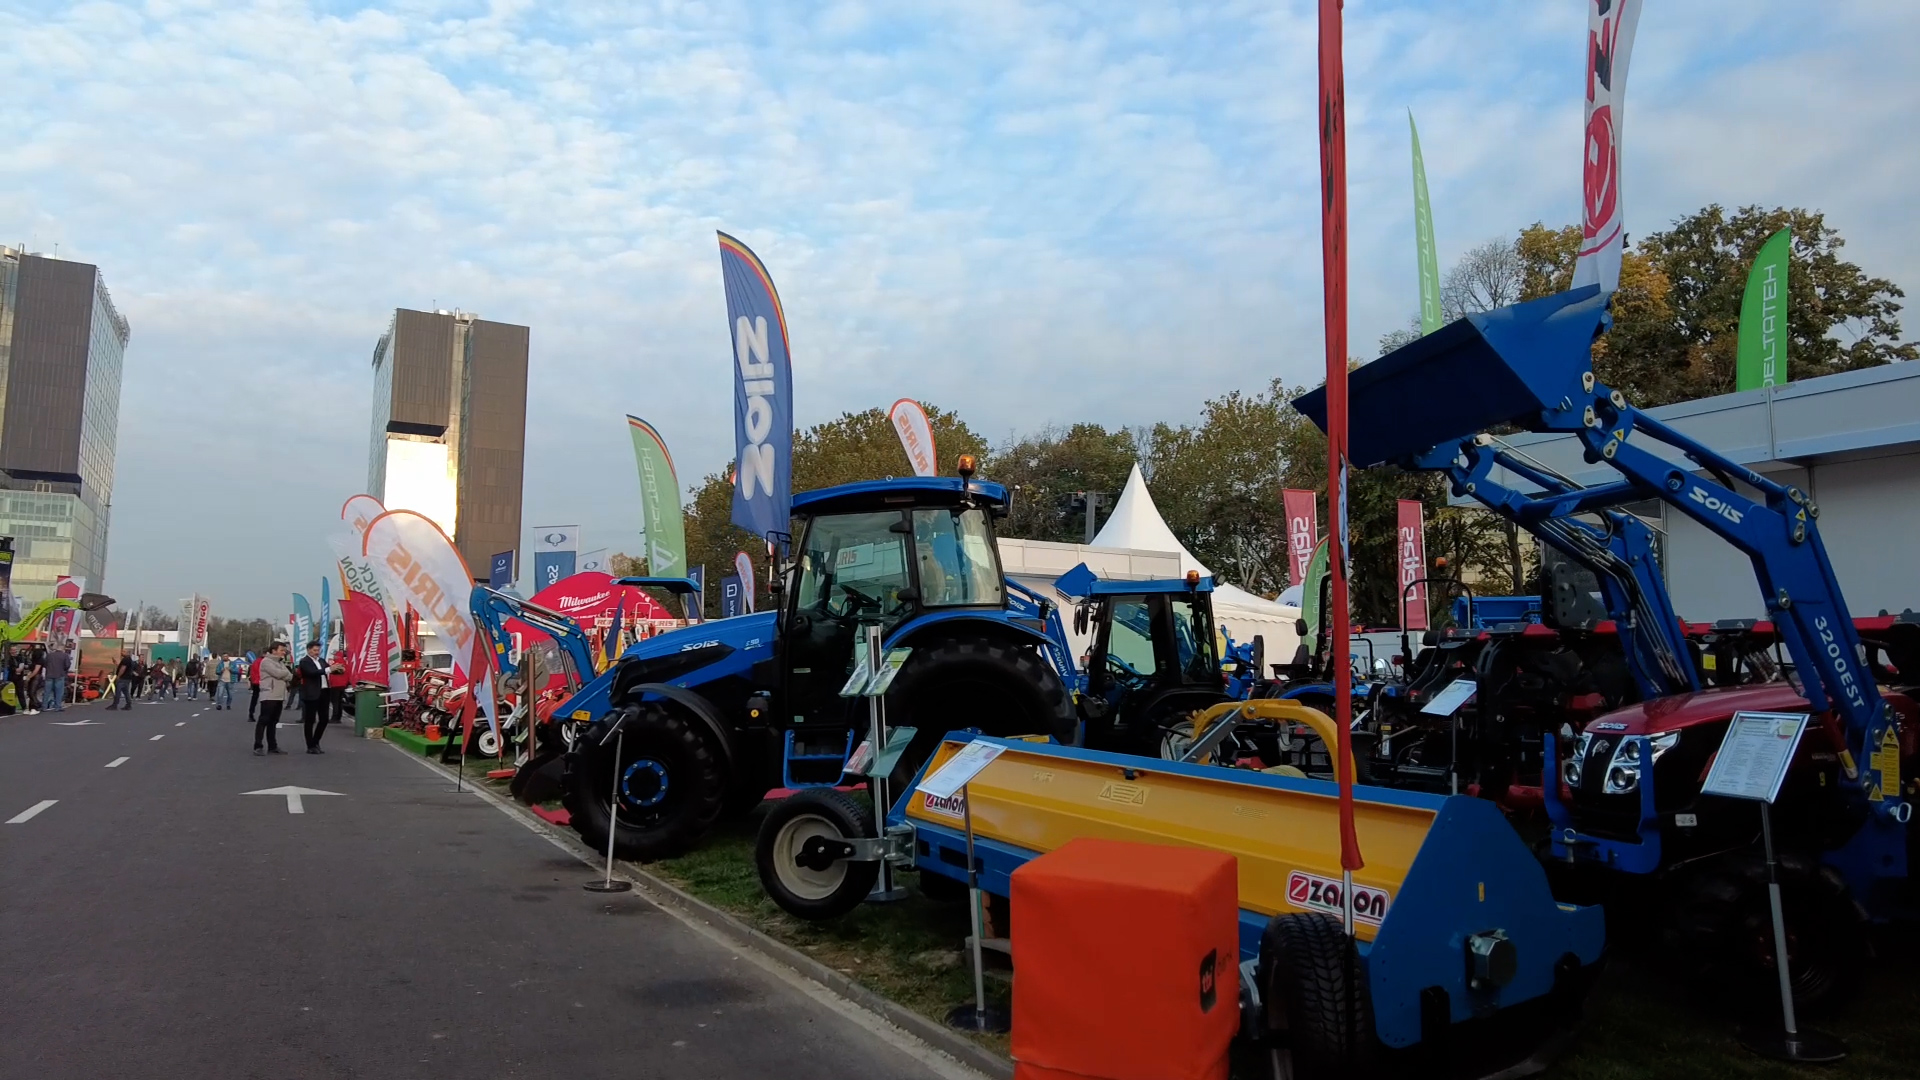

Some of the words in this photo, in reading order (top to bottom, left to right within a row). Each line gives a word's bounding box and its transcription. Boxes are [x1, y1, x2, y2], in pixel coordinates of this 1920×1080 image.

[1763, 264, 1777, 387] DELTATEH
[1689, 485, 1744, 525] Solis
[557, 590, 611, 609] Milwaukee
[681, 639, 720, 652] Solis
[1814, 616, 1865, 710] 3200EST
